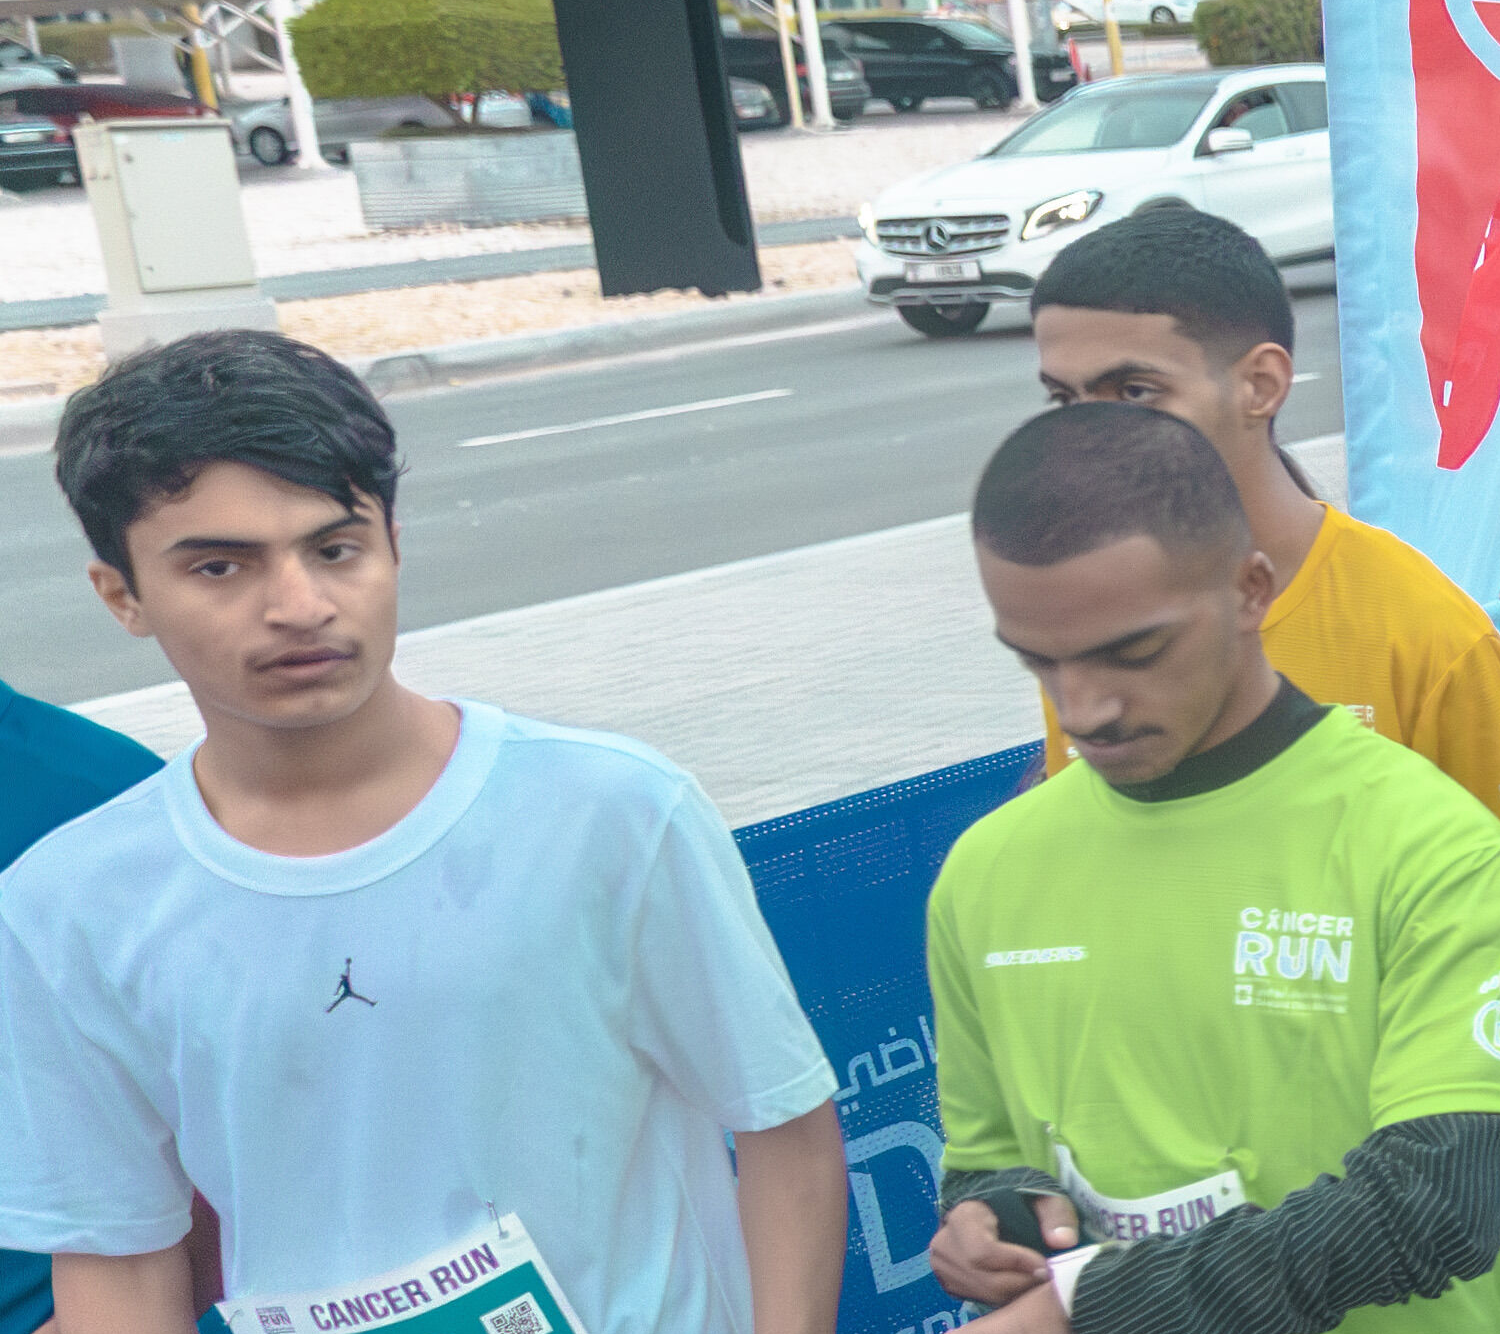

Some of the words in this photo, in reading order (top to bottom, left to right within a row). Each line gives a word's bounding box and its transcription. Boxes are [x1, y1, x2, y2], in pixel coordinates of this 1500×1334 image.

[1240, 907, 1355, 937] CANCER
[1234, 931, 1353, 983] RUN
[1158, 1194, 1215, 1236] RUN
[310, 1279, 431, 1332] CANCER
[430, 1242, 501, 1296] RUN
